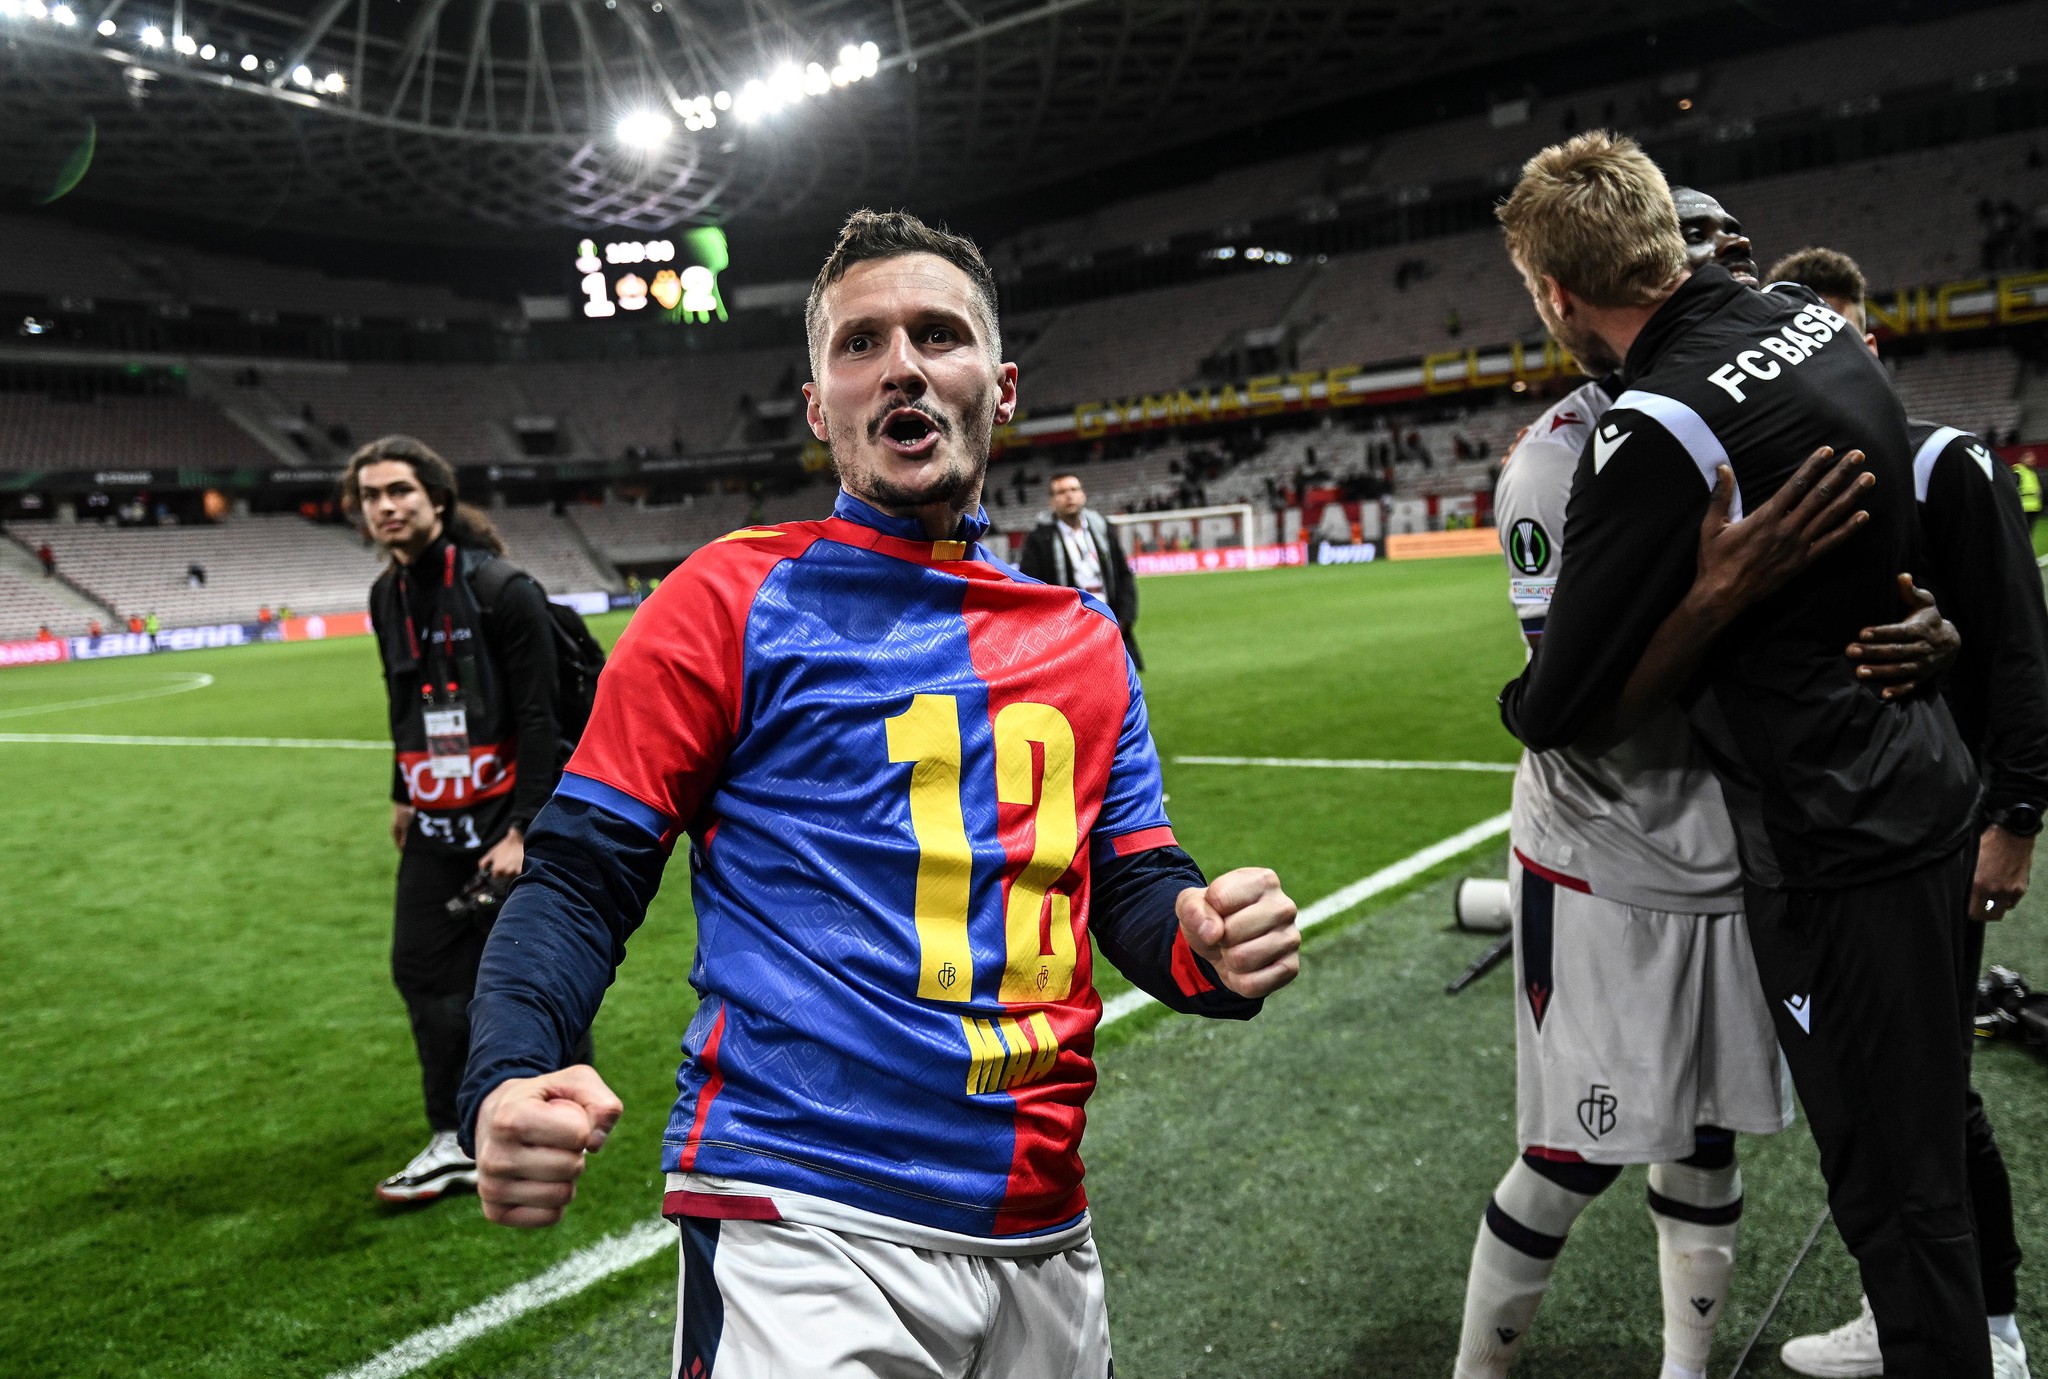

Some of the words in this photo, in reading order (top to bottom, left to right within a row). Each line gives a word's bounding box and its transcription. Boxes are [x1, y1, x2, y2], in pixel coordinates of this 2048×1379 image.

[1706, 350, 1782, 404] FC
[1759, 303, 1847, 366] BASE
[1317, 540, 1377, 566] bwin
[884, 693, 1076, 1003] 12
